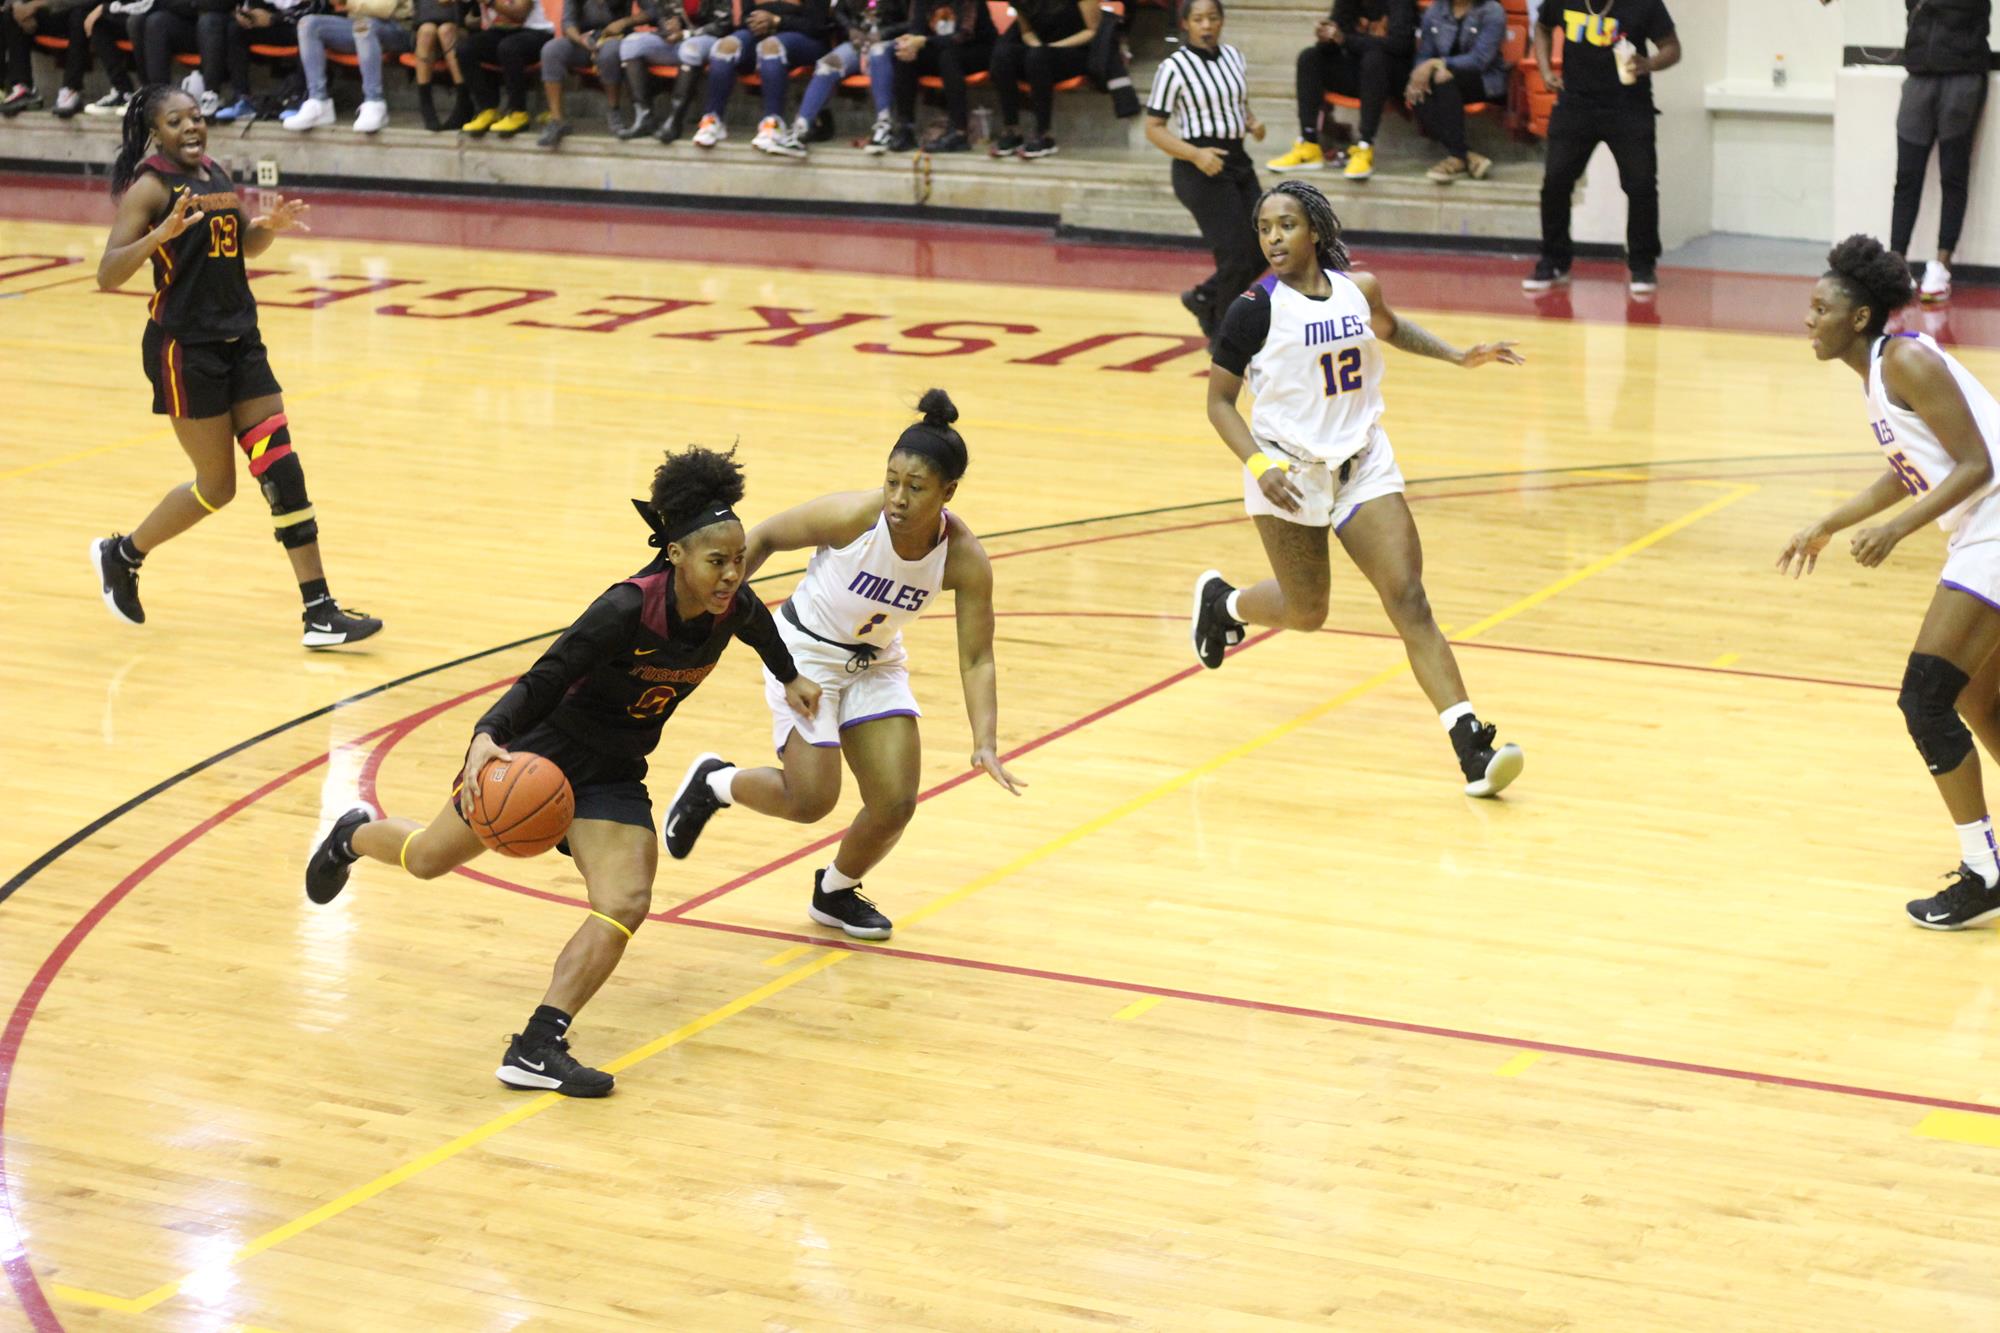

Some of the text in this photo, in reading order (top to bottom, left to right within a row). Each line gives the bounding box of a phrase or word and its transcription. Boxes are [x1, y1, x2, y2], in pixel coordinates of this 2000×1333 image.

[1563, 9, 1618, 47] TU
[208, 214, 238, 257] 13
[95, 268, 1210, 378] USKEGE
[1305, 315, 1364, 347] MILES
[1320, 346, 1363, 397] 12
[847, 570, 930, 612] MILES
